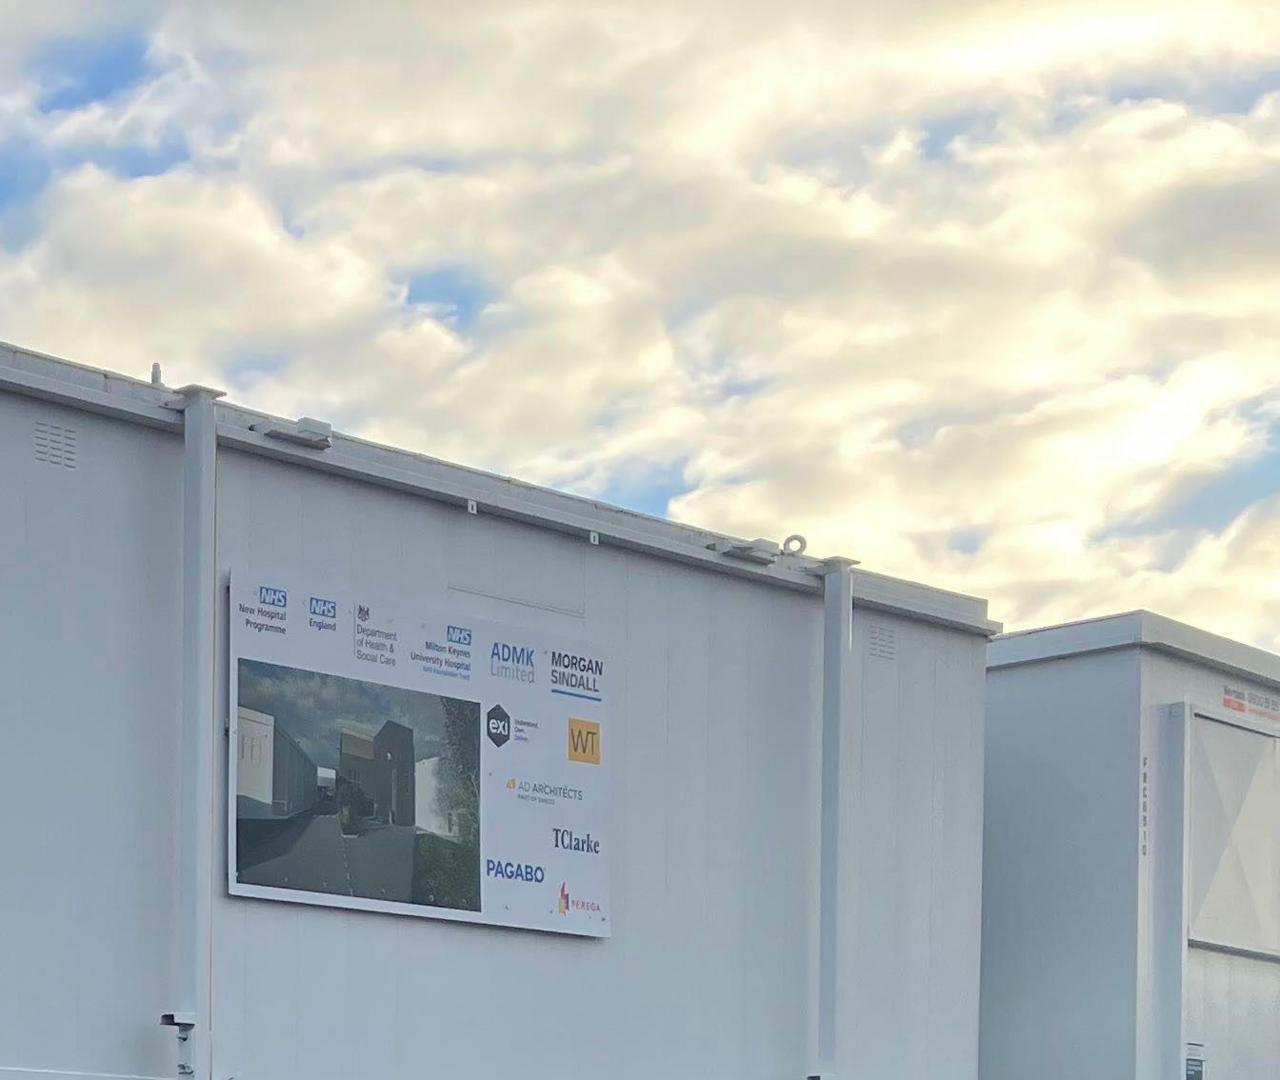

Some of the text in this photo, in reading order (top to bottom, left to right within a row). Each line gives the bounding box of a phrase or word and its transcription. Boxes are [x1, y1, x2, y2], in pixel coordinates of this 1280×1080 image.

[260, 587, 287, 607] NHS
[310, 597, 336, 618] NHS
[309, 617, 336, 632] England
[447, 626, 472, 646] NHS
[491, 642, 535, 667] ADMK
[551, 651, 604, 676] MORGAN
[490, 661, 535, 684] Limited
[551, 669, 600, 693] SINDALL
[571, 727, 598, 756] WT
[552, 827, 601, 854] TClarke
[486, 858, 545, 884] PAGABO
